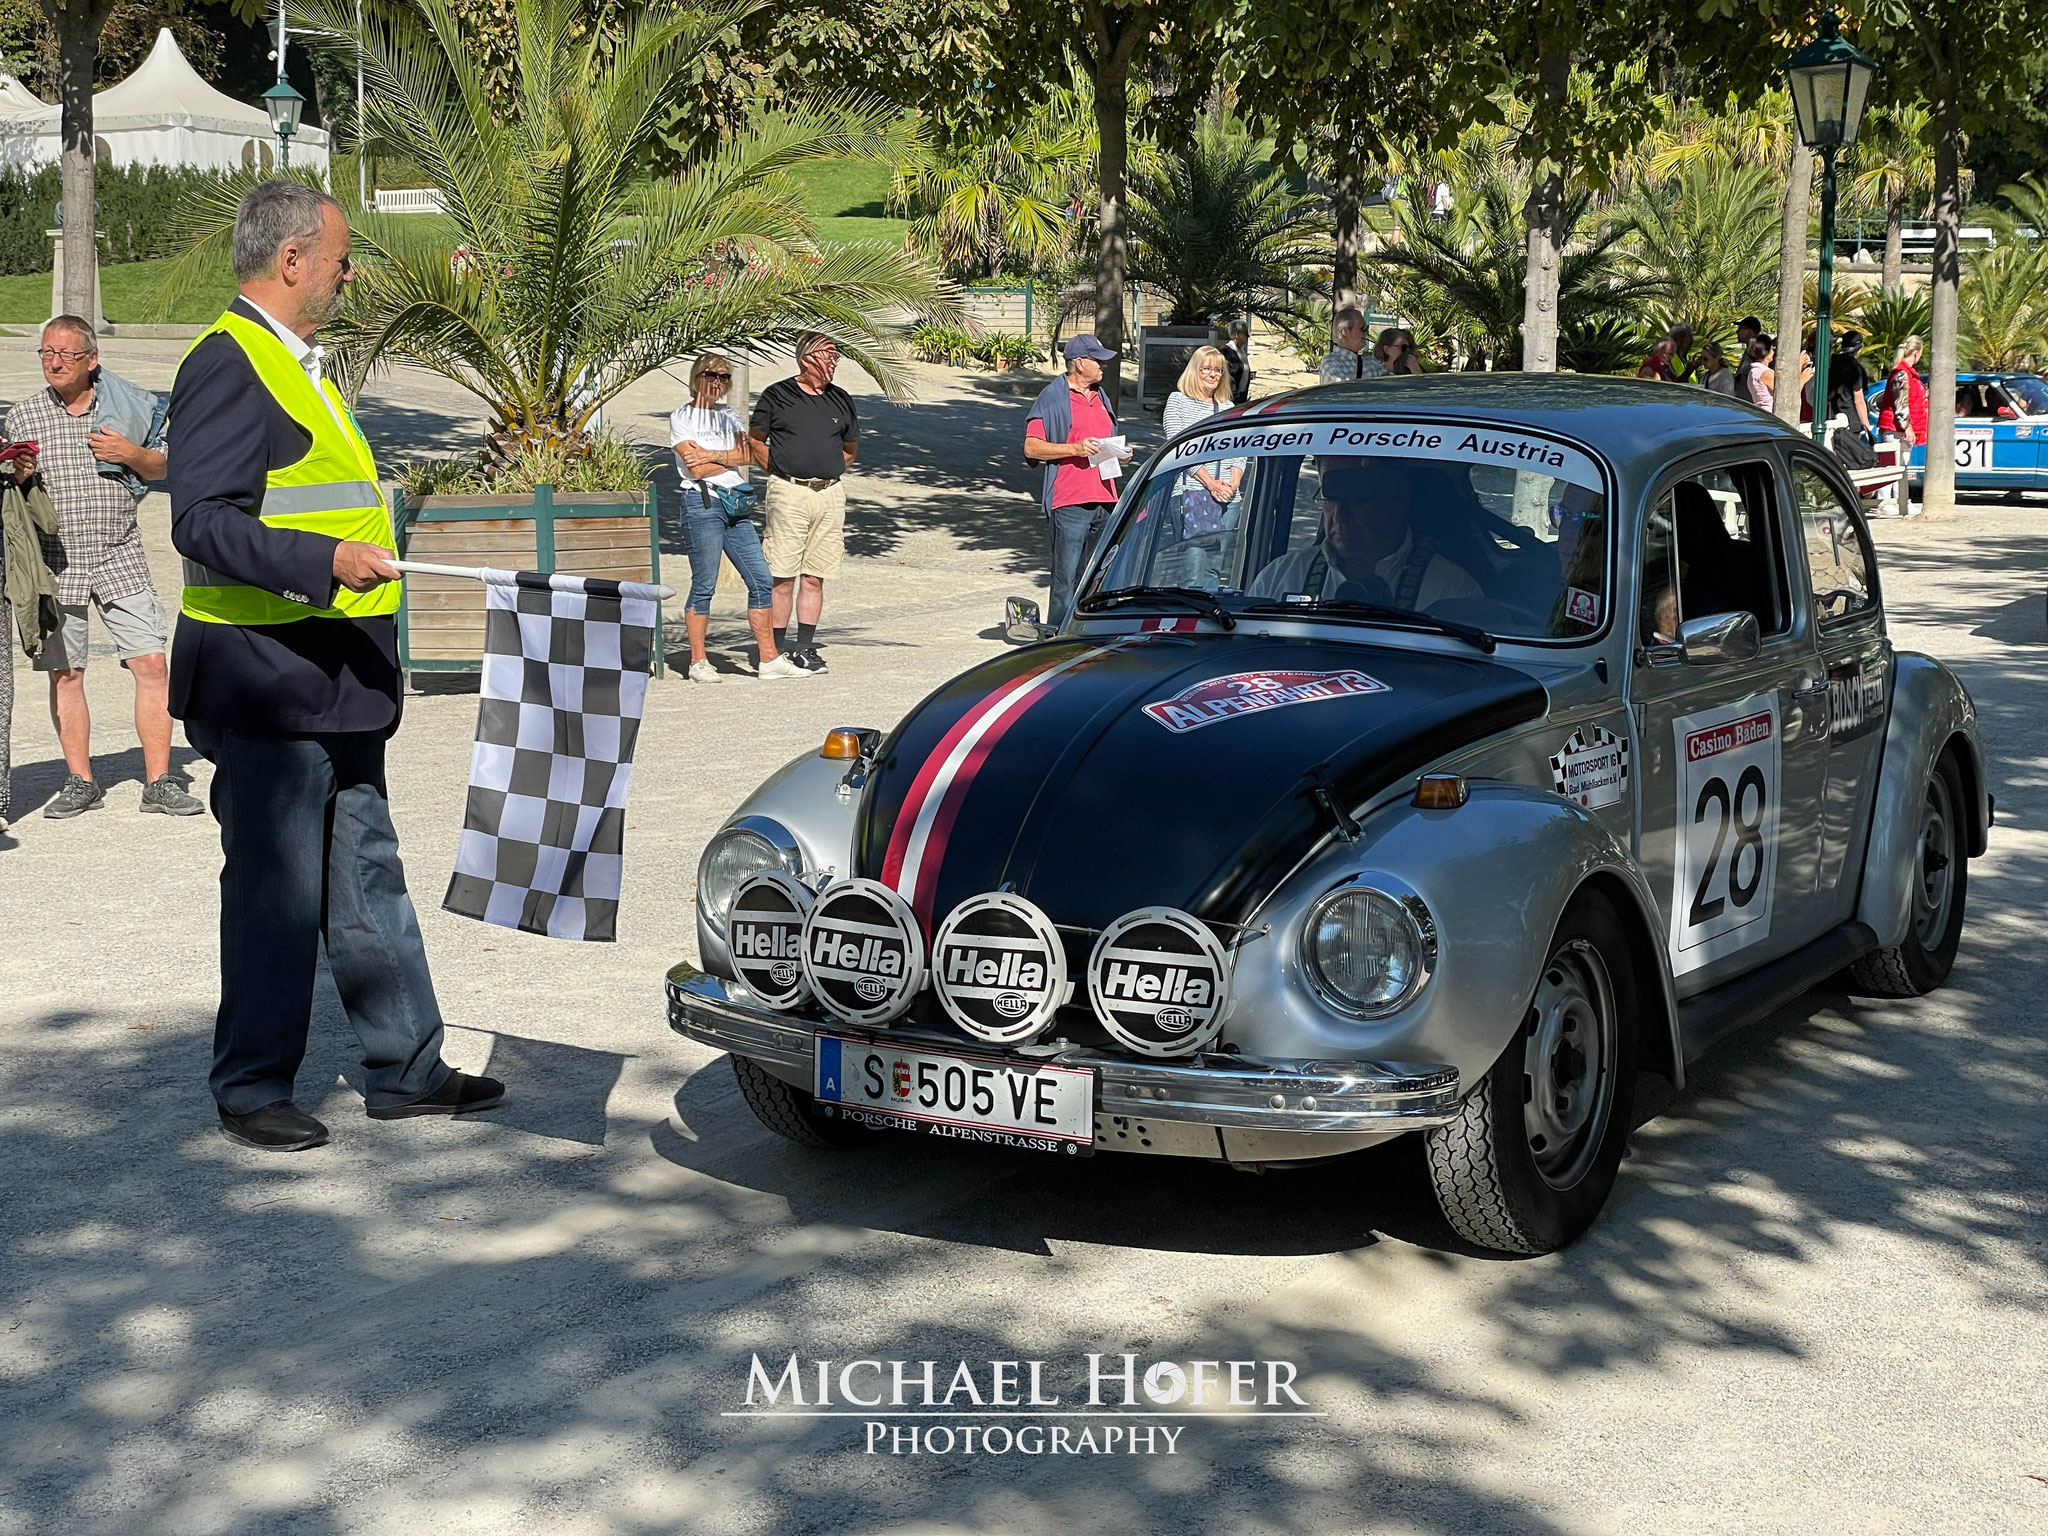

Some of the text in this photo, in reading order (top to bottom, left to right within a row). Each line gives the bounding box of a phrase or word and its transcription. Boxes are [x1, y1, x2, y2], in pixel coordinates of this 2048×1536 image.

[1174, 427, 1565, 468] Volkswagen Porsche Austria
[1954, 439, 1986, 467] 31
[1227, 677, 1283, 695] 28
[1831, 674, 1864, 734] BOSCH
[1690, 720, 1769, 759] Casino Baden
[1568, 755, 1608, 778] MOTORSPORT
[1569, 782, 1579, 795] Bad
[1689, 764, 1766, 927] 28
[736, 924, 801, 958] Hella
[813, 930, 902, 975] Hella
[947, 949, 1044, 989] Hella
[1104, 962, 1211, 1005] Hella
[858, 980, 886, 997] HELLA
[997, 998, 1027, 1011] HELLA
[1159, 1013, 1193, 1027] HELLA
[825, 1077, 836, 1091] A
[864, 1054, 1058, 1125] S 505 VE
[842, 1109, 1058, 1152] PORSCHE ALPENSTRASSE
